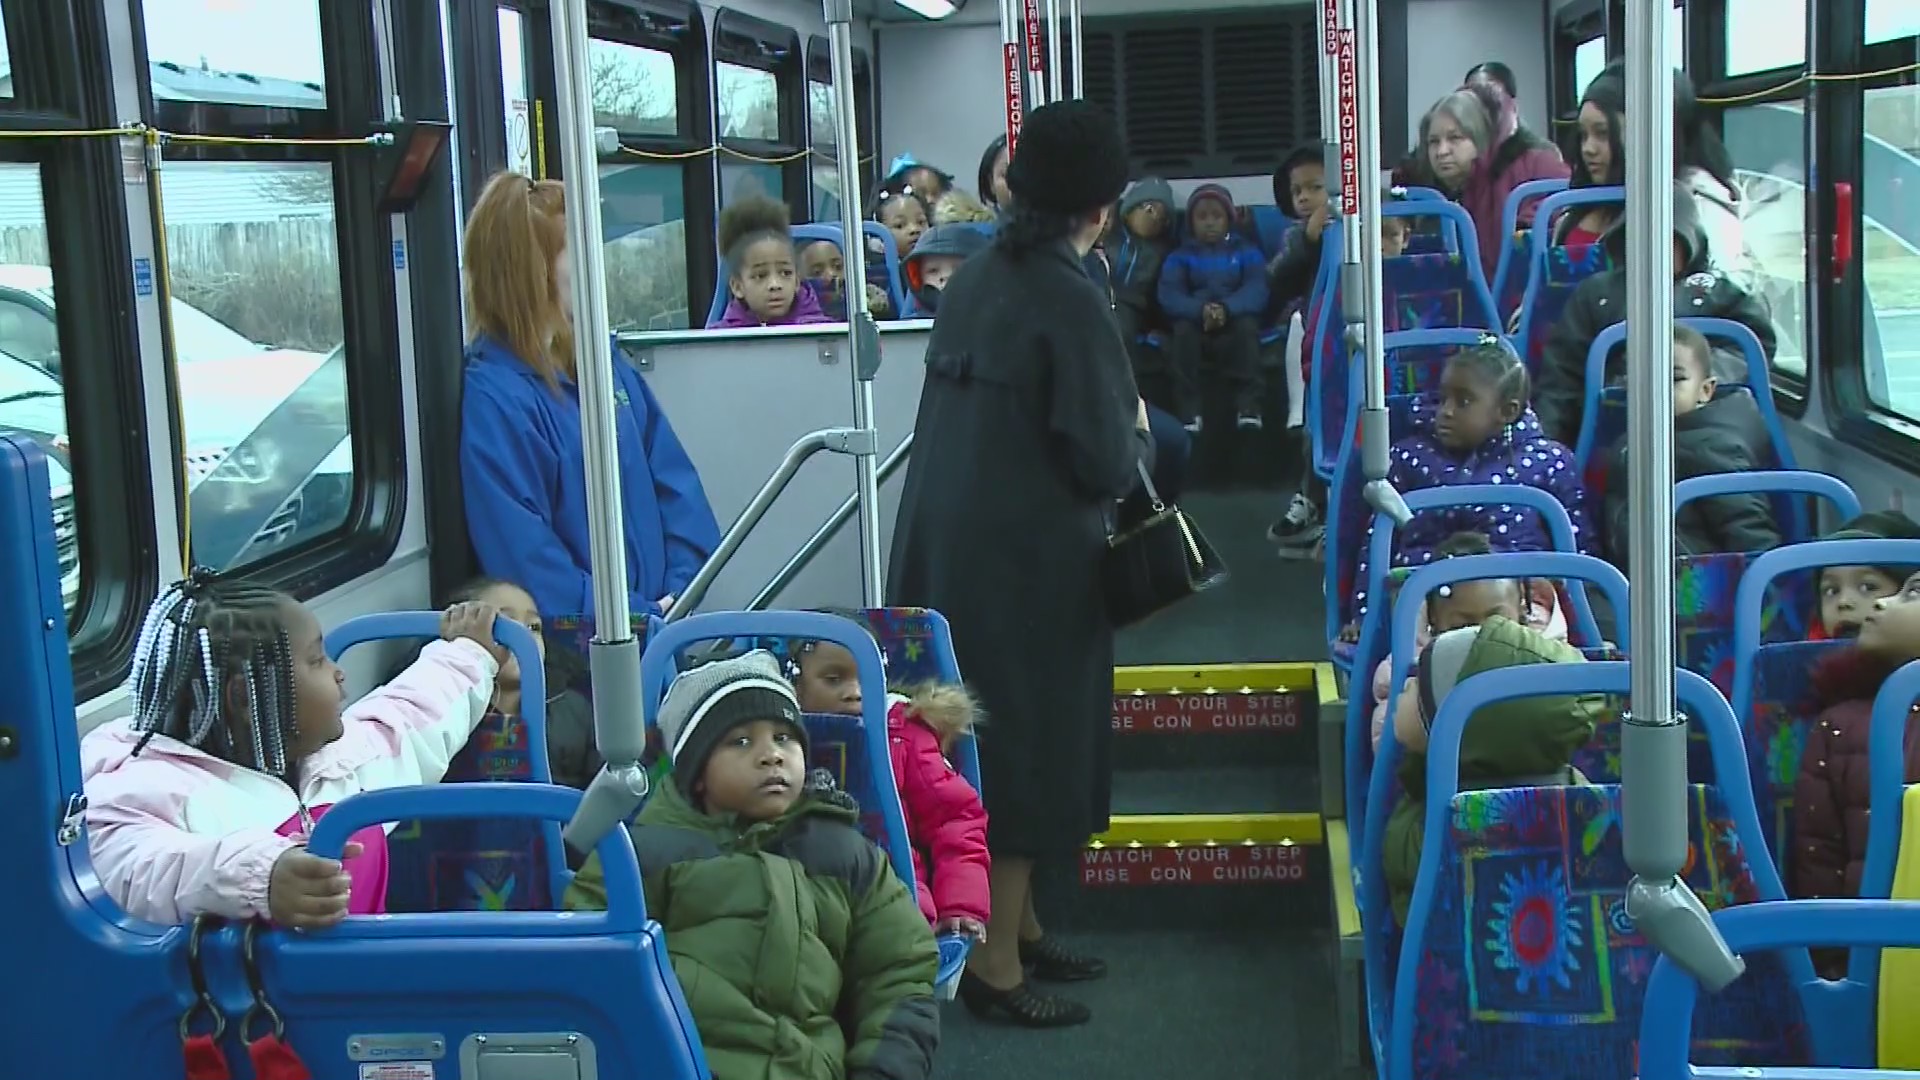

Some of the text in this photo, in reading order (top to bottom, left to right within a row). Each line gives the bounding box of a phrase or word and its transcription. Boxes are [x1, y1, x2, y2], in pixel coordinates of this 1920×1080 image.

[1027, 0, 1040, 68] UR STEP
[1326, 0, 1336, 51] IDADO
[1008, 44, 1019, 94] PISE
[1011, 99, 1021, 136] CON
[1340, 31, 1355, 210] WATCH YOUR STEP
[1112, 695, 1297, 712] TCH YOUR STEP
[1112, 713, 1297, 729] SE CON CUIDADO
[1084, 846, 1301, 864] WATCH YOUR STEP
[1085, 865, 1302, 883] PISE CON CUIDADO
